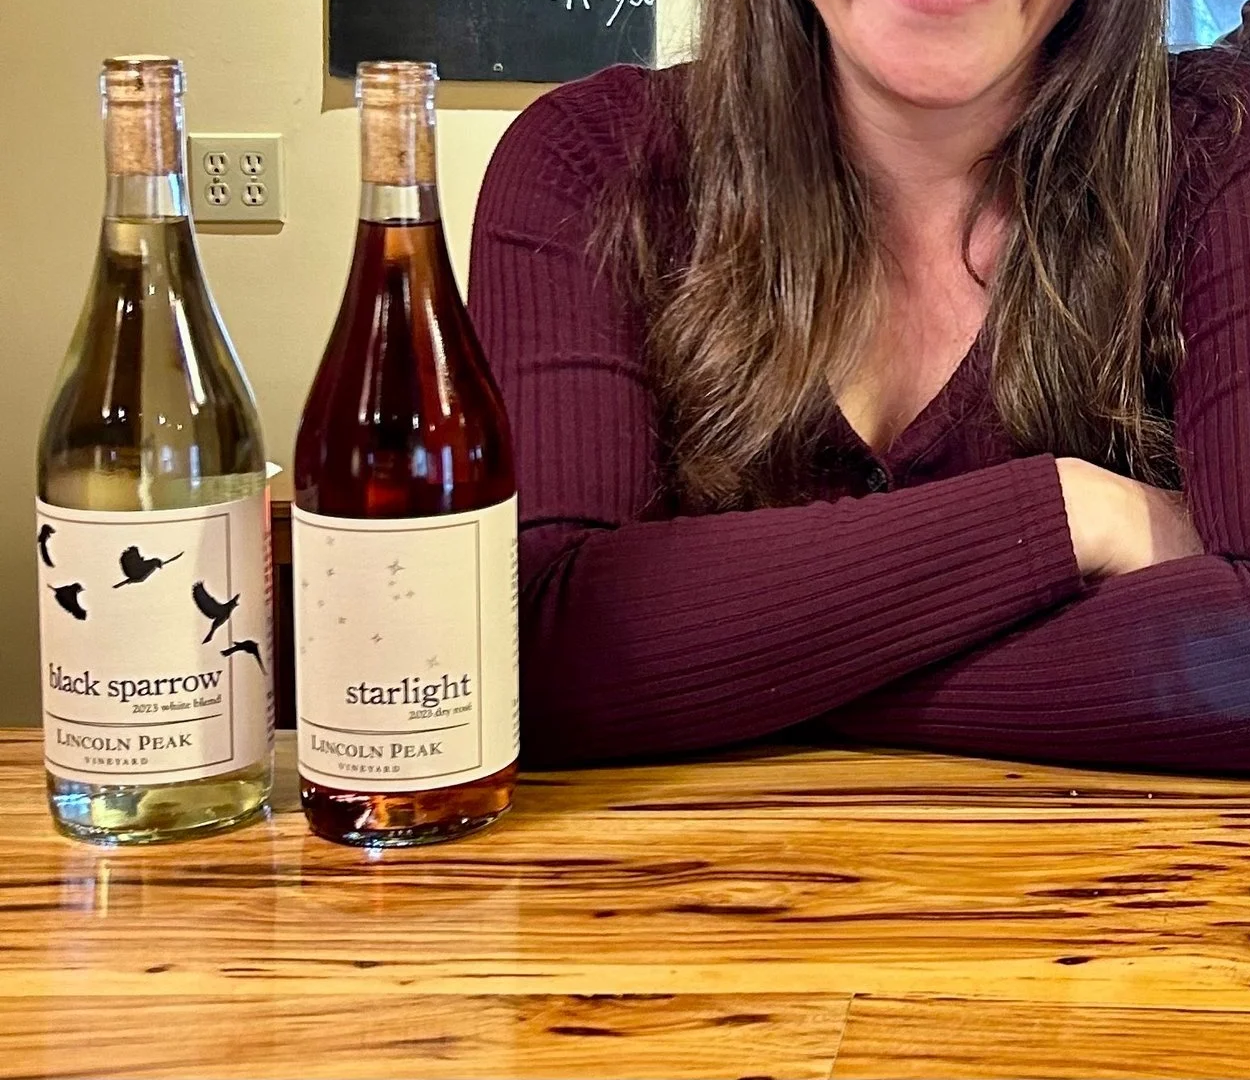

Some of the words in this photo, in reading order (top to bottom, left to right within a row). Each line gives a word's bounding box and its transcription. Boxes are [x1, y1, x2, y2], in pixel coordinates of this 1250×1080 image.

[49, 663, 101, 697] black
[107, 670, 223, 703] sparrow
[346, 673, 472, 708] starlight
[133, 703, 159, 714] 2023
[409, 709, 433, 721] 2023
[57, 728, 131, 751] LINCOLN
[139, 733, 193, 751] PEAK
[311, 734, 384, 759] LINCOLN
[391, 741, 443, 759] PEAK
[84, 756, 149, 767] VINEYARD
[338, 762, 401, 773] VINEYARD
